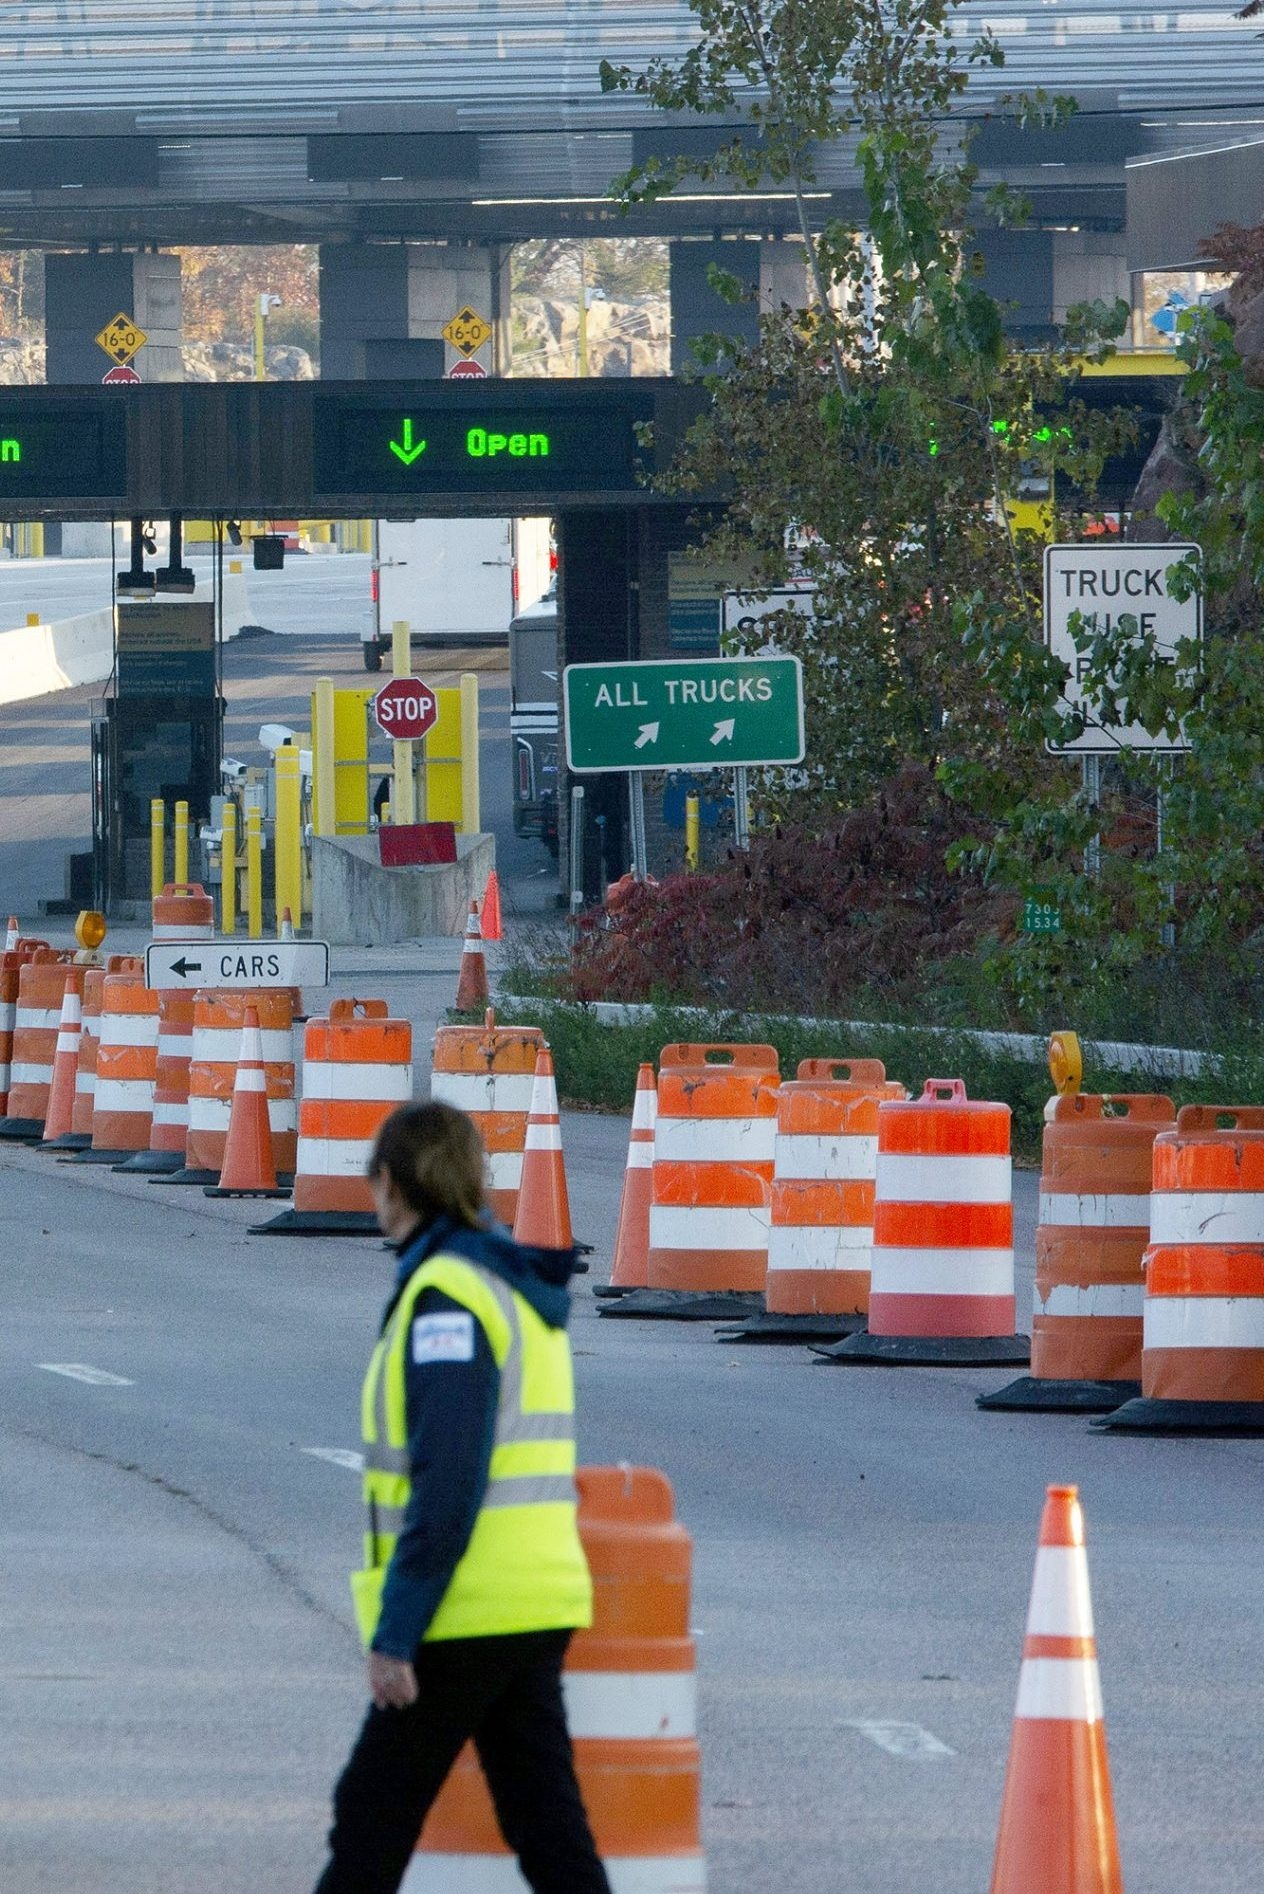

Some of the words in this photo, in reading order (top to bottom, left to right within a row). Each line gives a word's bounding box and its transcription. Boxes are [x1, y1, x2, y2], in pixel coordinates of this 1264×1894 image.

[467, 428, 549, 456] Open
[1060, 569, 1168, 597] TRUCK
[594, 681, 648, 708] ALL
[664, 677, 773, 705] TRUCKS
[380, 696, 433, 722] STOP
[220, 954, 280, 978] CARS
